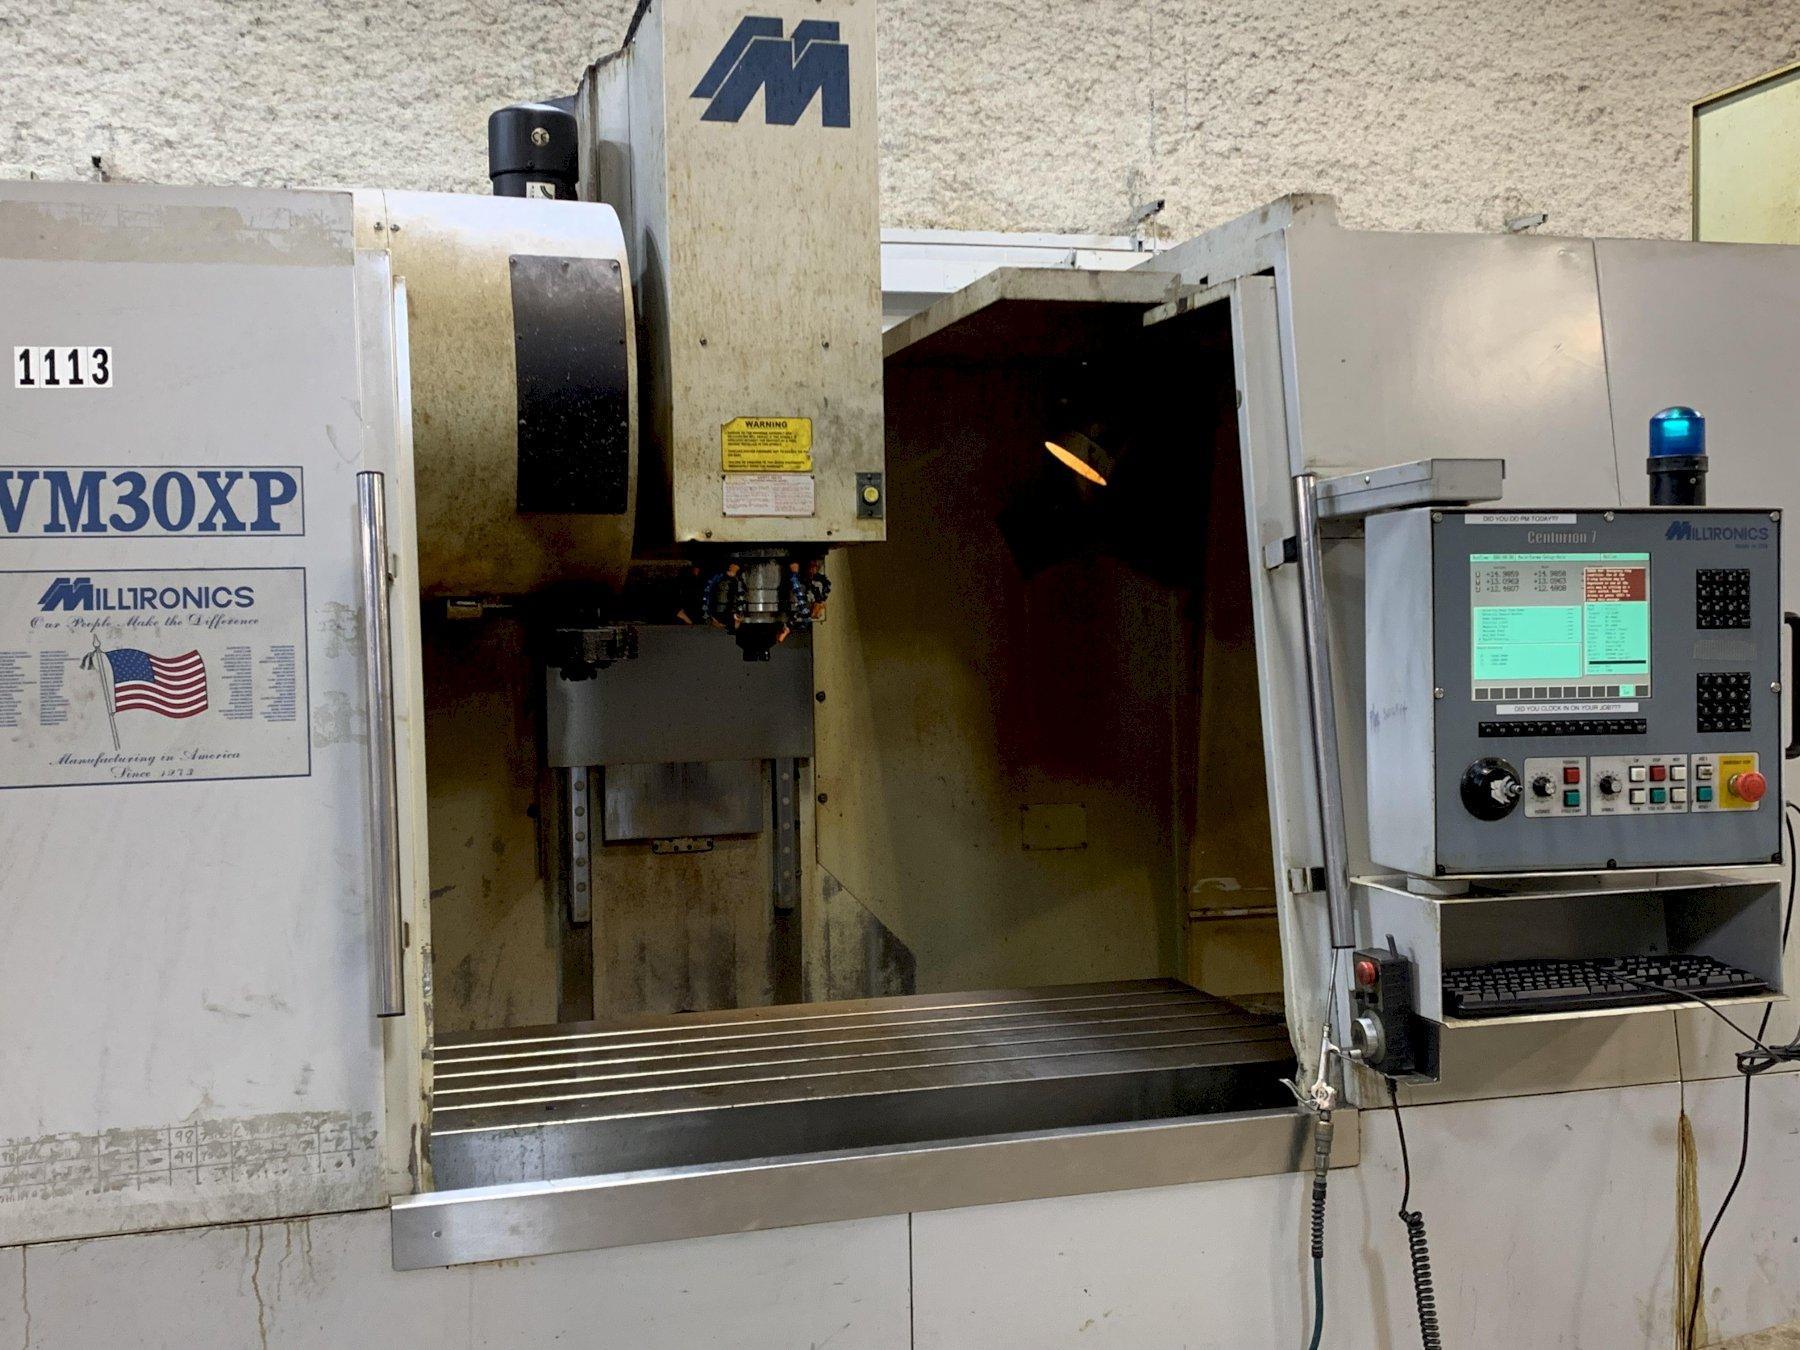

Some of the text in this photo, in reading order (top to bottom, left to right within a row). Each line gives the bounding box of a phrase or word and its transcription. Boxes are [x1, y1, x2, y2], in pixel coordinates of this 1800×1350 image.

[18, 348, 110, 386] 1113
[745, 420, 788, 429] WARNING
[0, 470, 298, 533] VM30XP
[1527, 530, 1587, 544] Centurion
[1665, 520, 1769, 541] MILLTRONICS
[37, 577, 255, 612] MILLTRONICS
[67, 615, 112, 633] People
[116, 615, 160, 627] Make
[163, 615, 183, 627] the
[187, 612, 260, 631] Difference
[49, 748, 241, 768] Manufacturing in America
[110, 765, 151, 779] Since
